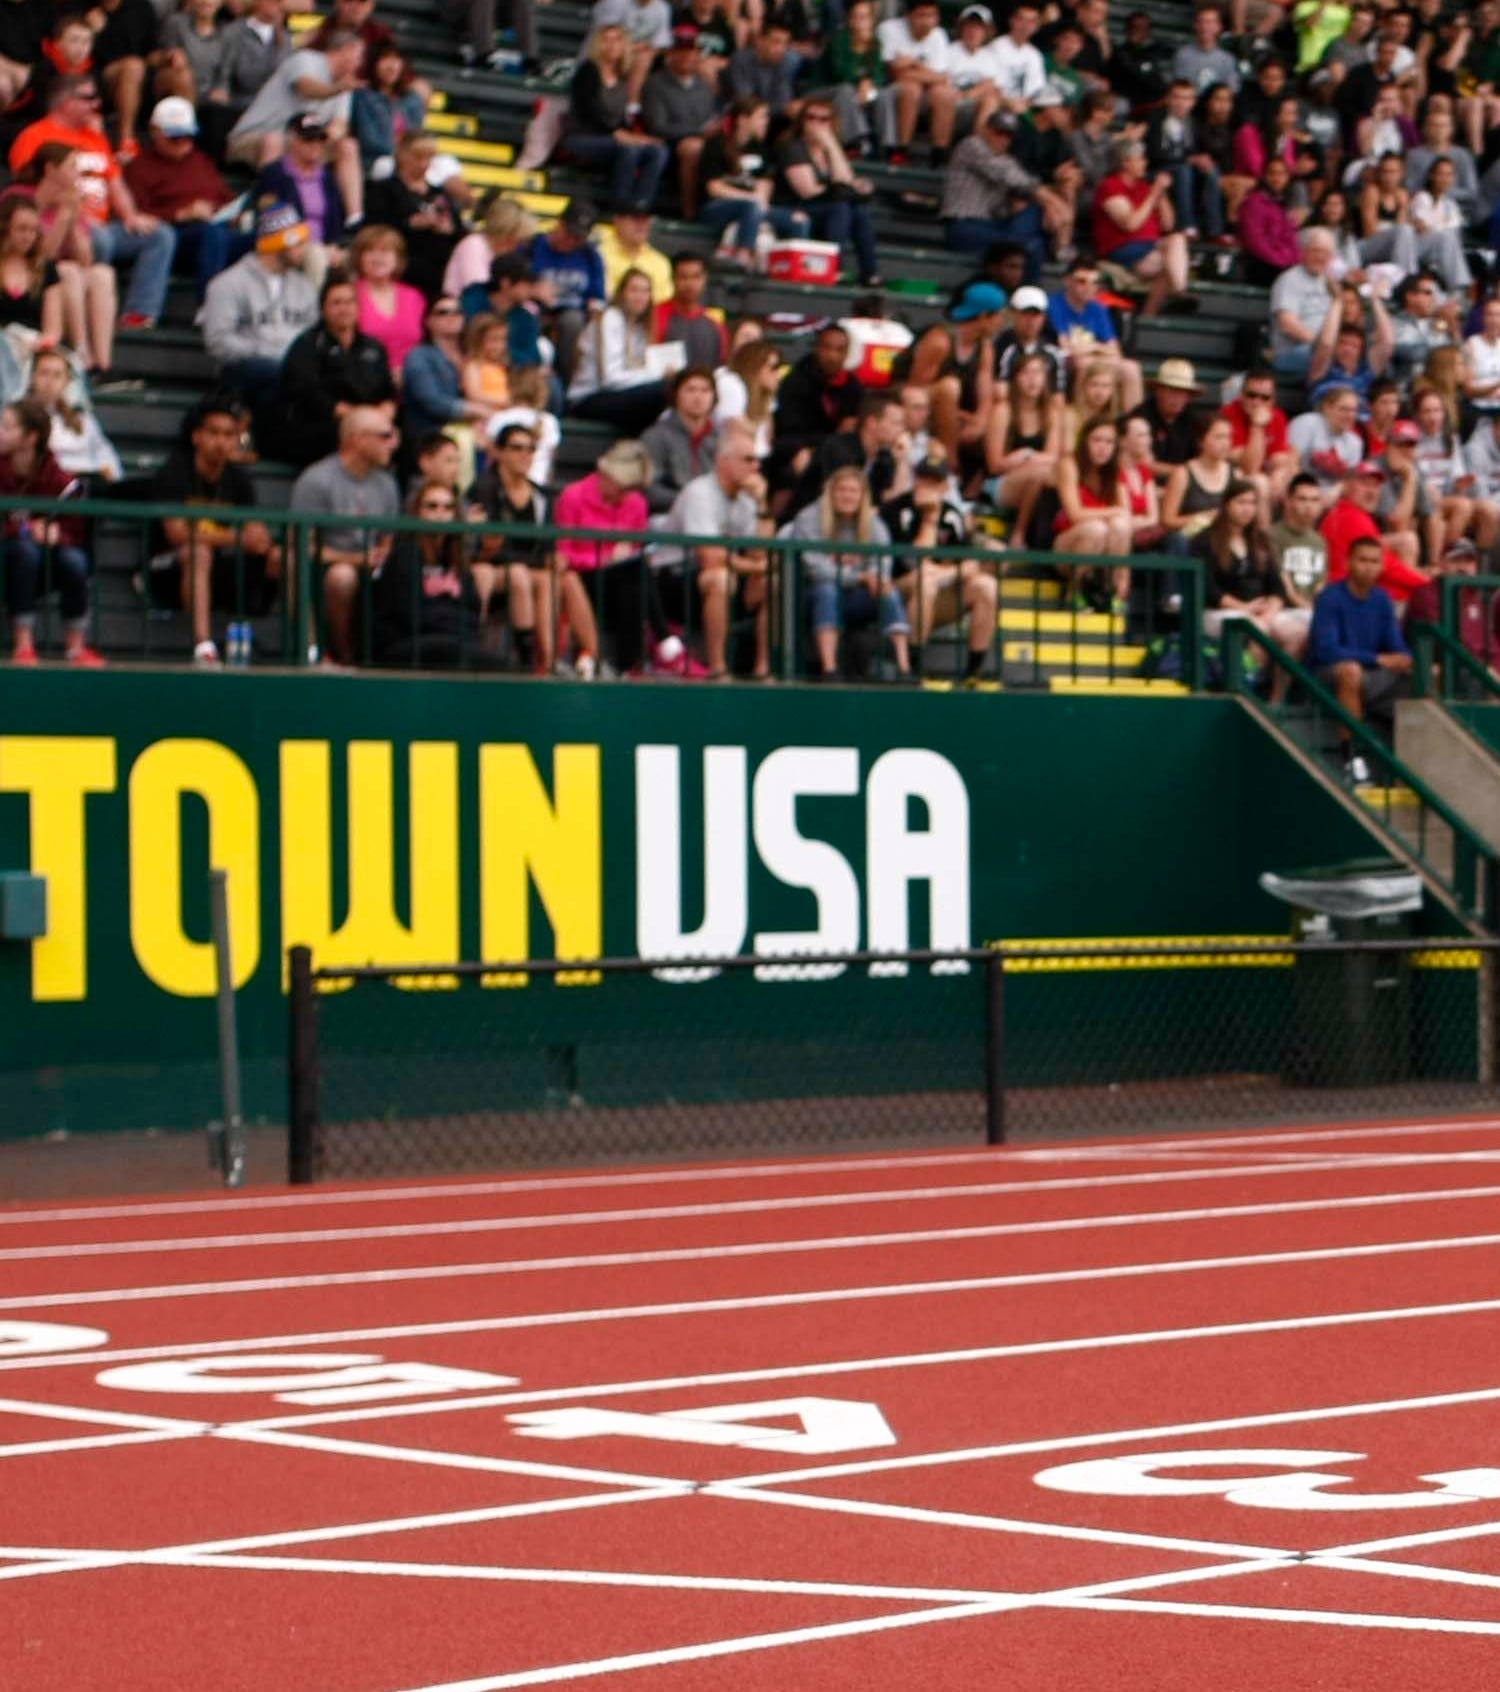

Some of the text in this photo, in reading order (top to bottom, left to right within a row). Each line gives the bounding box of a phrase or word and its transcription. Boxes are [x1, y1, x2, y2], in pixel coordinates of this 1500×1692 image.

[0, 736, 971, 1000] TOWN USA
[96, 1354, 521, 1405] 5
[504, 1397, 897, 1455] 4
